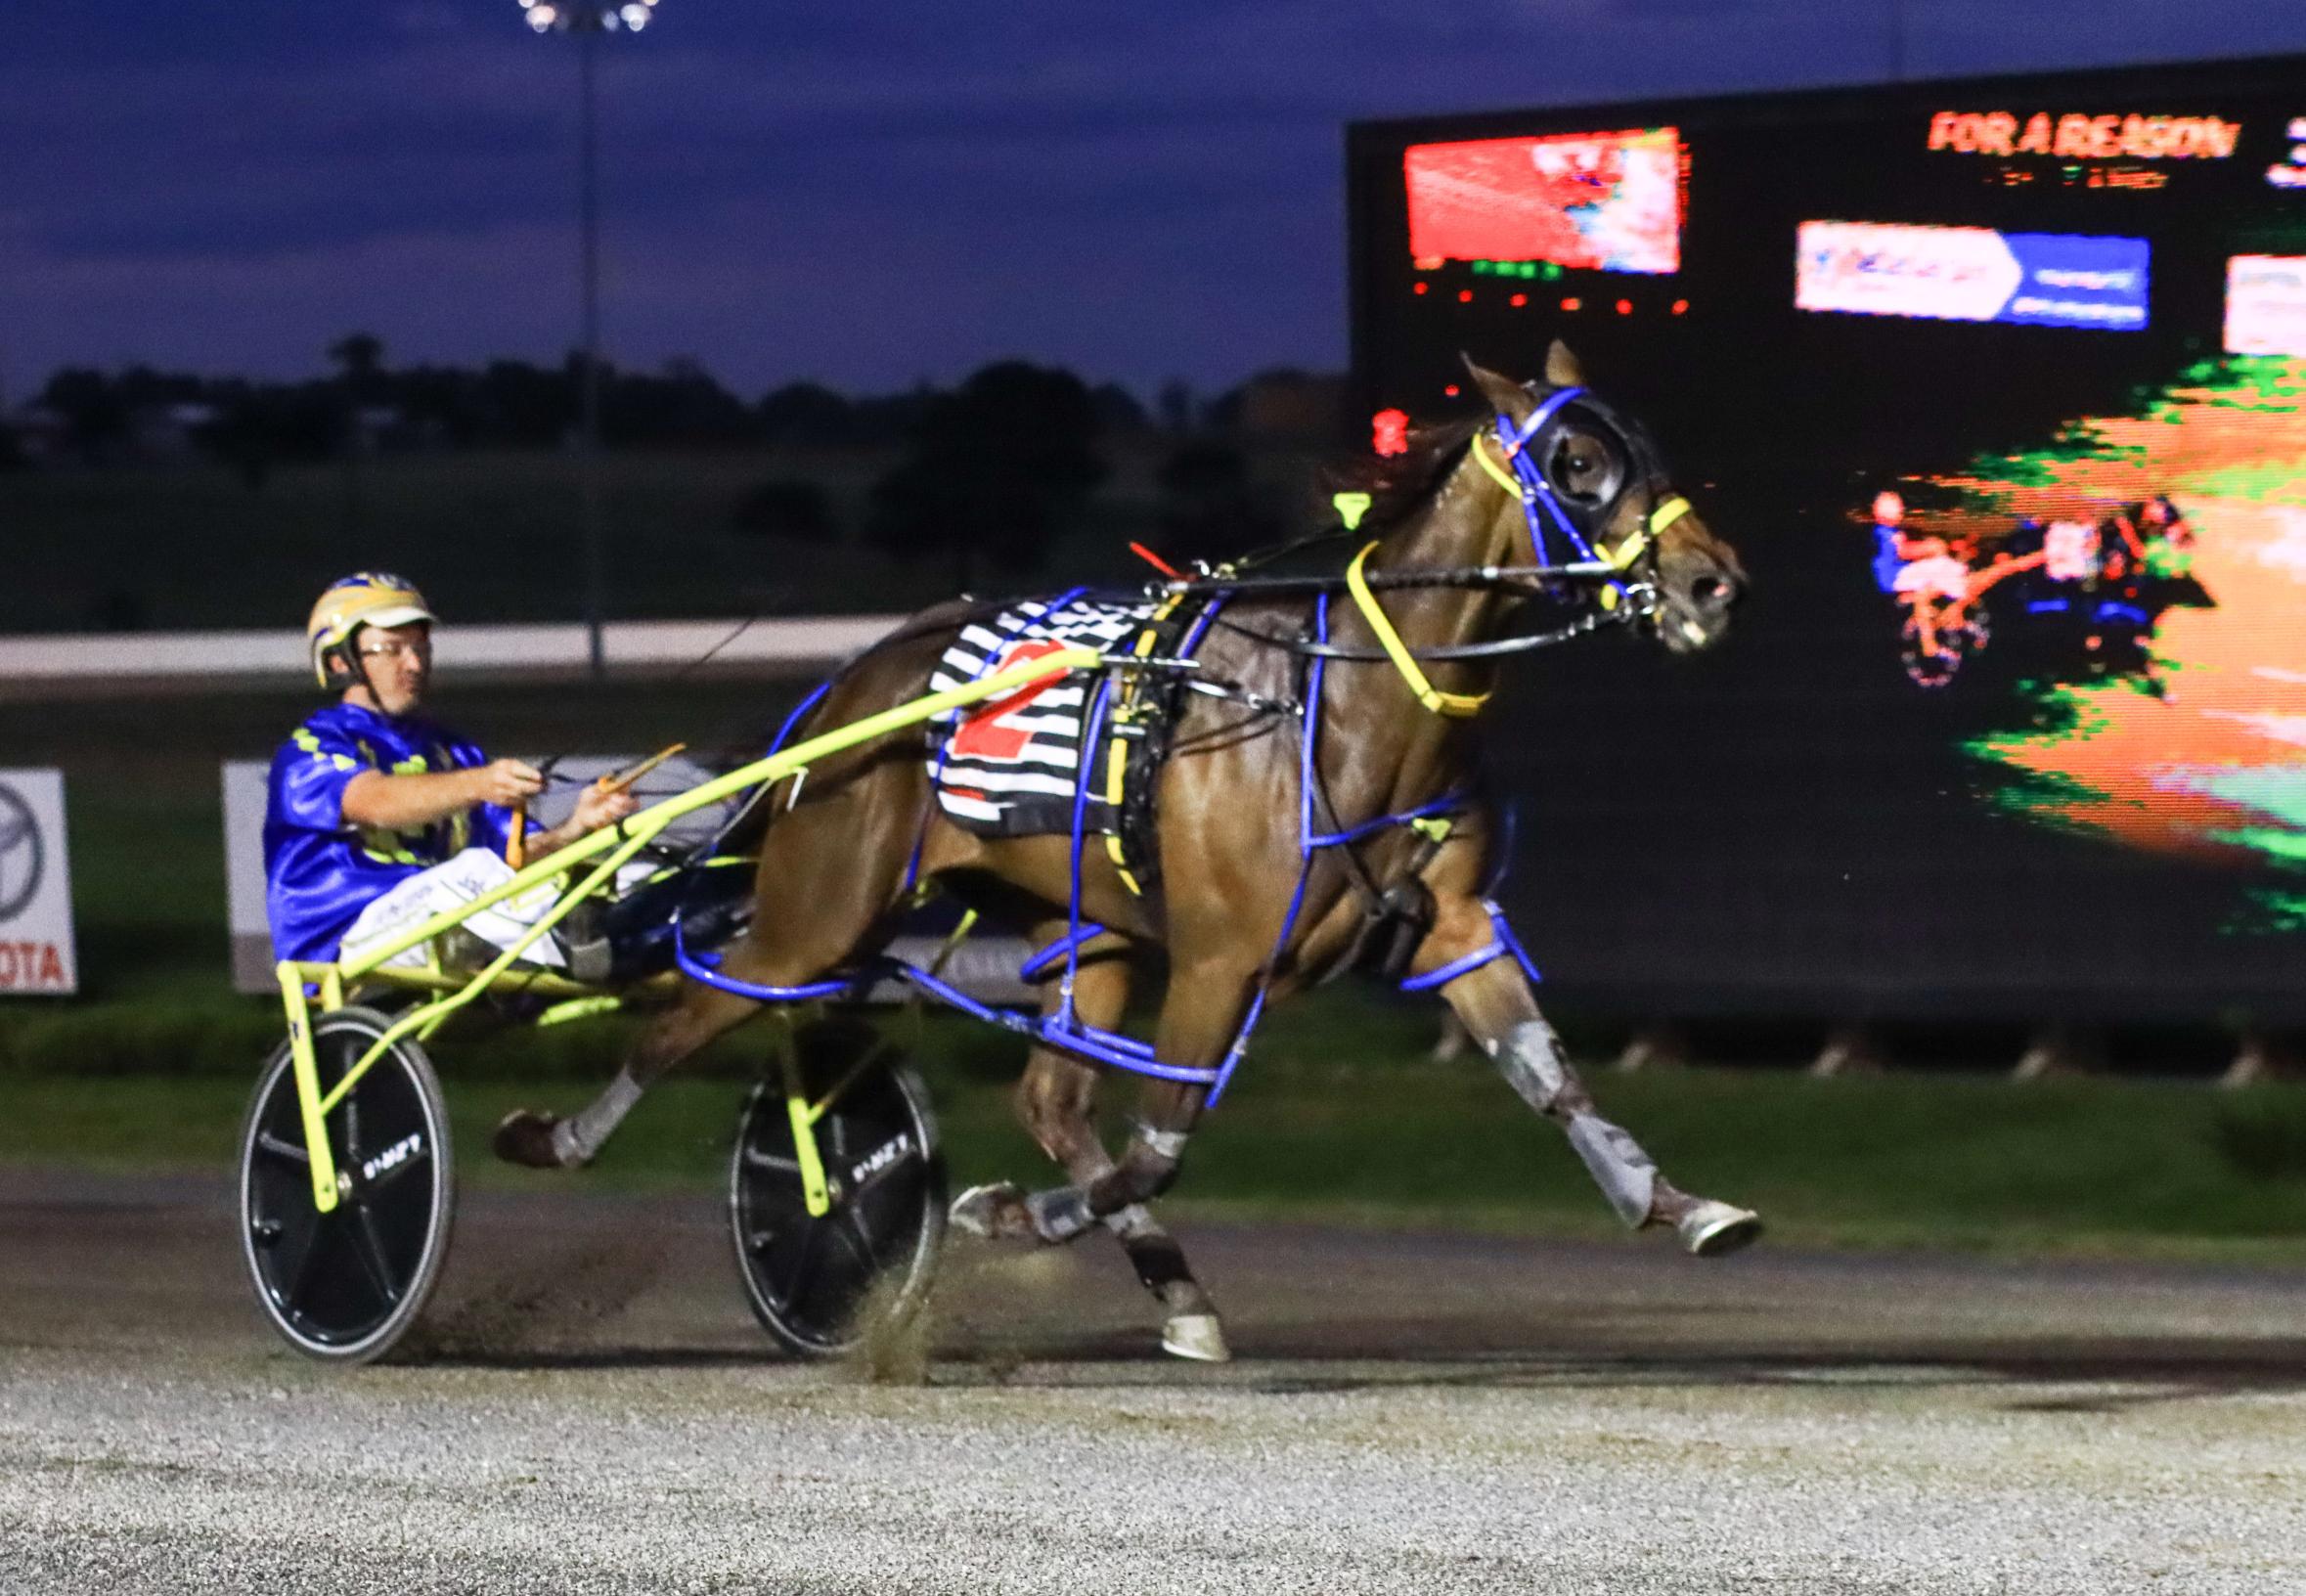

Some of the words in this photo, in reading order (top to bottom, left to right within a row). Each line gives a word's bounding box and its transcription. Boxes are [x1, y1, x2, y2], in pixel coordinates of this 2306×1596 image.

[1928, 111, 2018, 156] FOR
[2018, 111, 2052, 155] A
[2054, 112, 2241, 158] REASON
[953, 638, 1073, 759] 2
